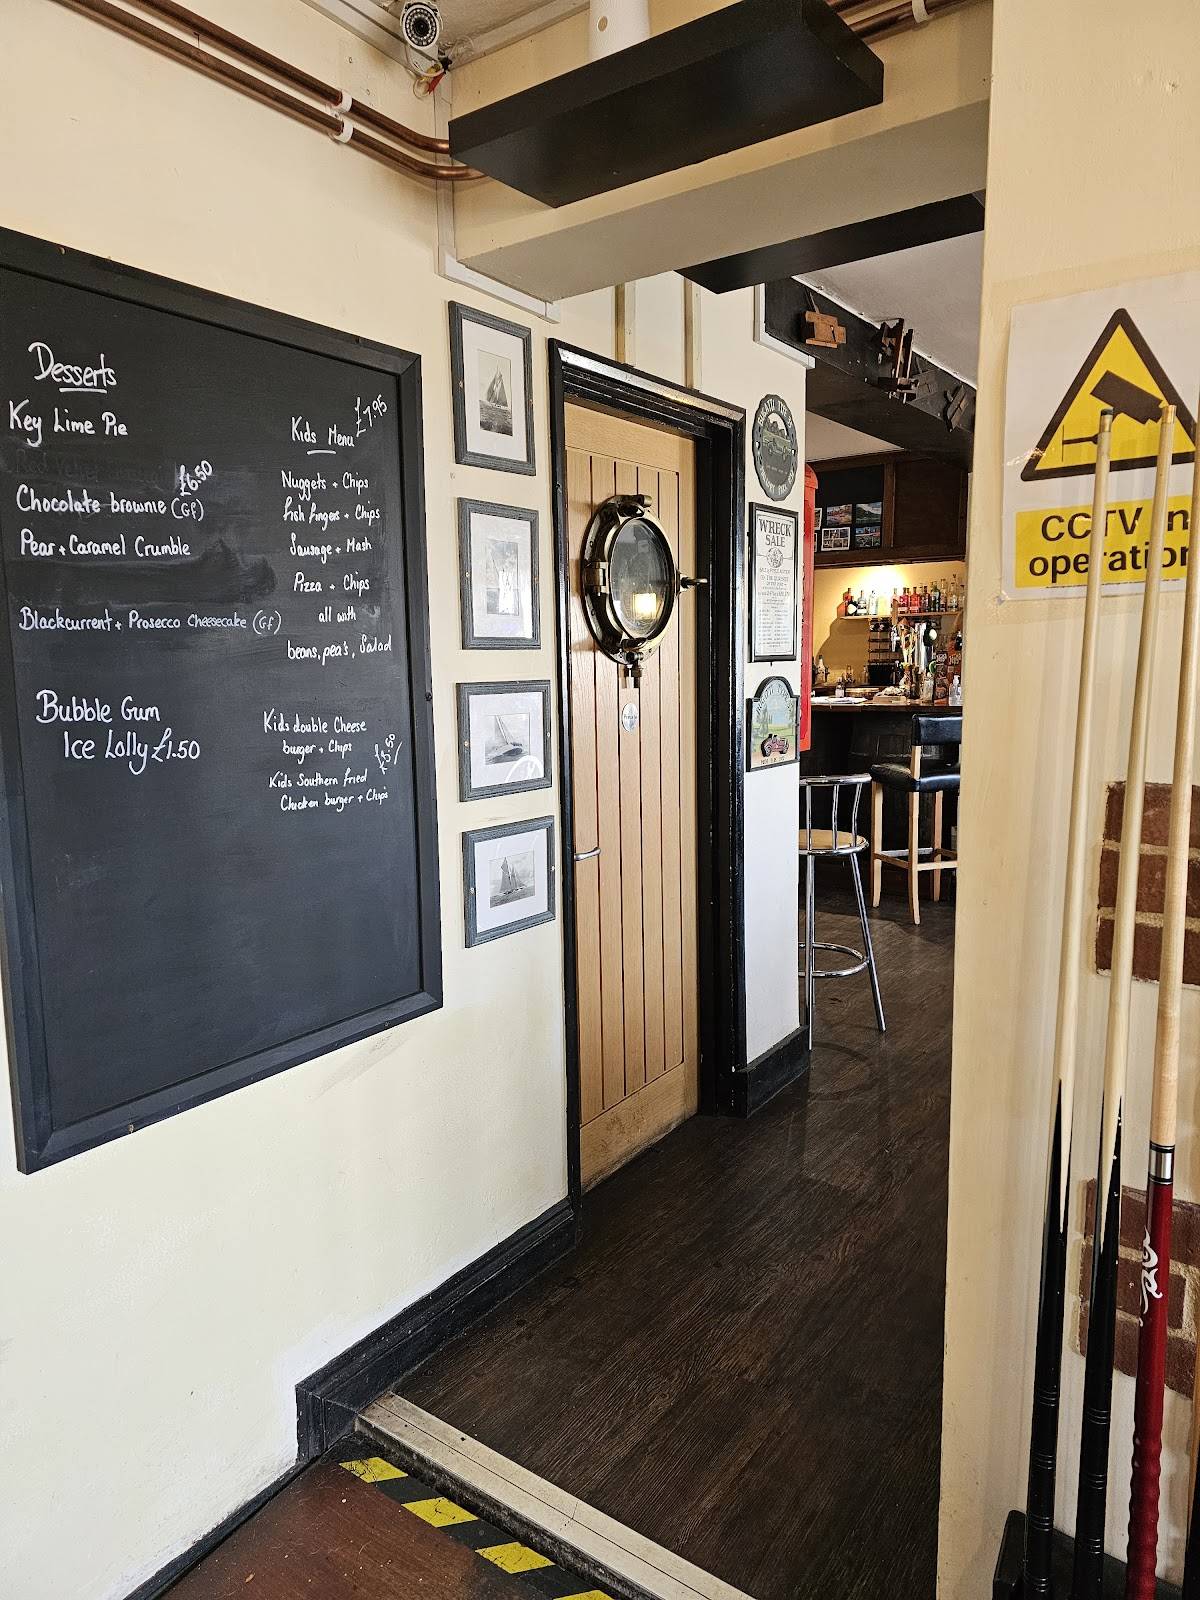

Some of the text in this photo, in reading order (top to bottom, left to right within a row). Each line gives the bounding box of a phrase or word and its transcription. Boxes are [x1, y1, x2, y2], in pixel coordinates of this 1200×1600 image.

[28, 341, 117, 387] Desserts
[9, 399, 128, 448] Key Lime Pie
[354, 393, 388, 438] £7.95
[291, 416, 355, 447] Kids Menu
[178, 460, 213, 497] £6.50
[281, 470, 327, 501] Nuggets
[342, 471, 369, 495] Chips
[16, 483, 101, 514] Chocolate
[110, 491, 167, 514] brownie
[355, 500, 380, 526] Chips
[1167, 509, 1189, 532] n
[758, 518, 792, 538] WRECK
[765, 534, 786, 548] SALE
[20, 528, 191, 557] Pear + Caramel Crumble
[290, 532, 332, 564] Sausage
[346, 536, 372, 553] Mash
[1029, 540, 1190, 583] opeatio
[293, 571, 322, 593] Pizza
[343, 571, 370, 597] Chips
[19, 606, 112, 631] Blackcurrent
[115, 621, 122, 630] +
[128, 610, 181, 629] Prosecco
[187, 612, 247, 629] Cheesecake
[318, 605, 357, 623] all with
[359, 633, 392, 654] Salad
[36, 689, 160, 723] Bubble Gum
[263, 708, 368, 733] Kids double Cheese
[64, 727, 200, 775] Ice Lolly £1.50
[282, 740, 316, 764] burger
[328, 739, 353, 759] Chips
[269, 771, 293, 788] Kids
[296, 772, 339, 787] Southern
[280, 786, 389, 812] Chicken burger + Chips
